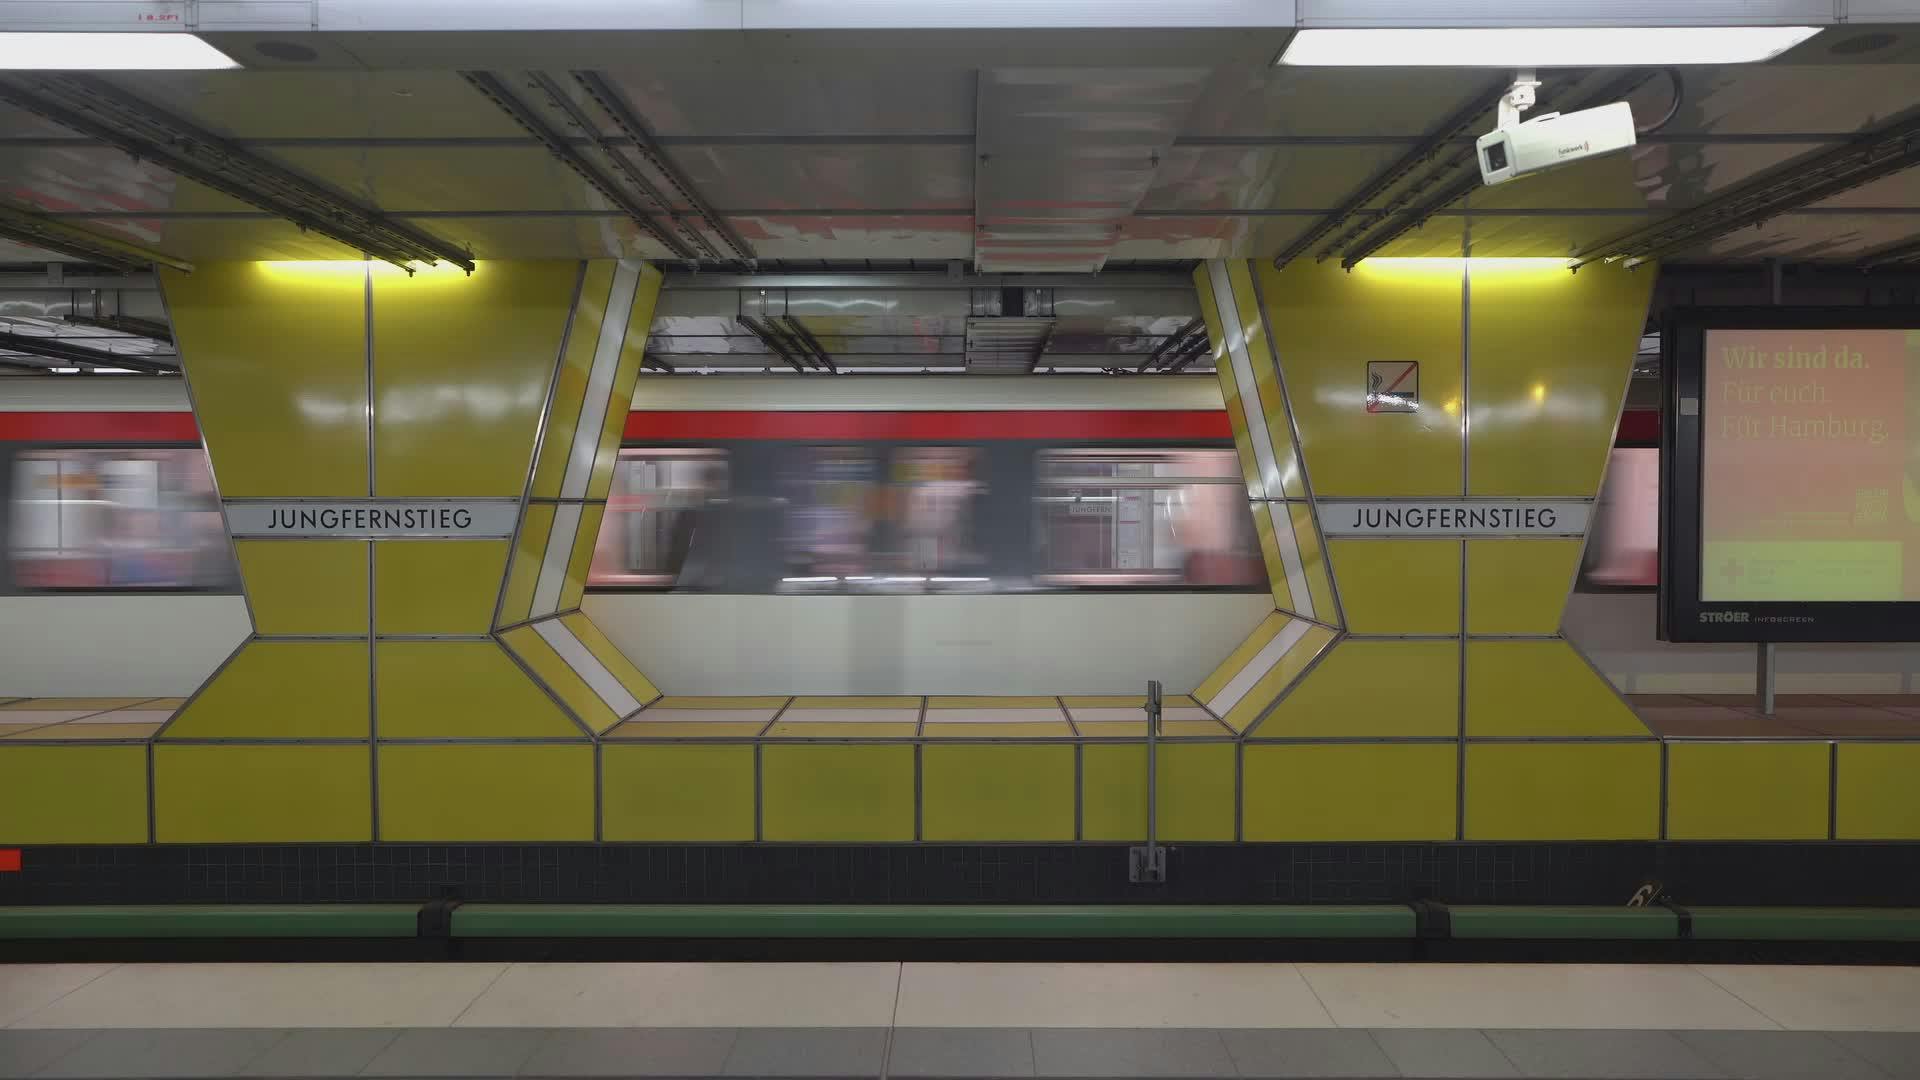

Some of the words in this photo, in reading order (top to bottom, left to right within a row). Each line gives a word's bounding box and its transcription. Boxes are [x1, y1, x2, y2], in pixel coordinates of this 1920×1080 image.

[1721, 346, 1768, 368] Wir
[1774, 344, 1826, 368] sind
[1835, 344, 1870, 368] da.
[268, 509, 472, 529] JUNGFERNSTIEG
[1353, 508, 1556, 528] JUNGFERNSTIEG
[1700, 611, 1749, 623] STRÖER
